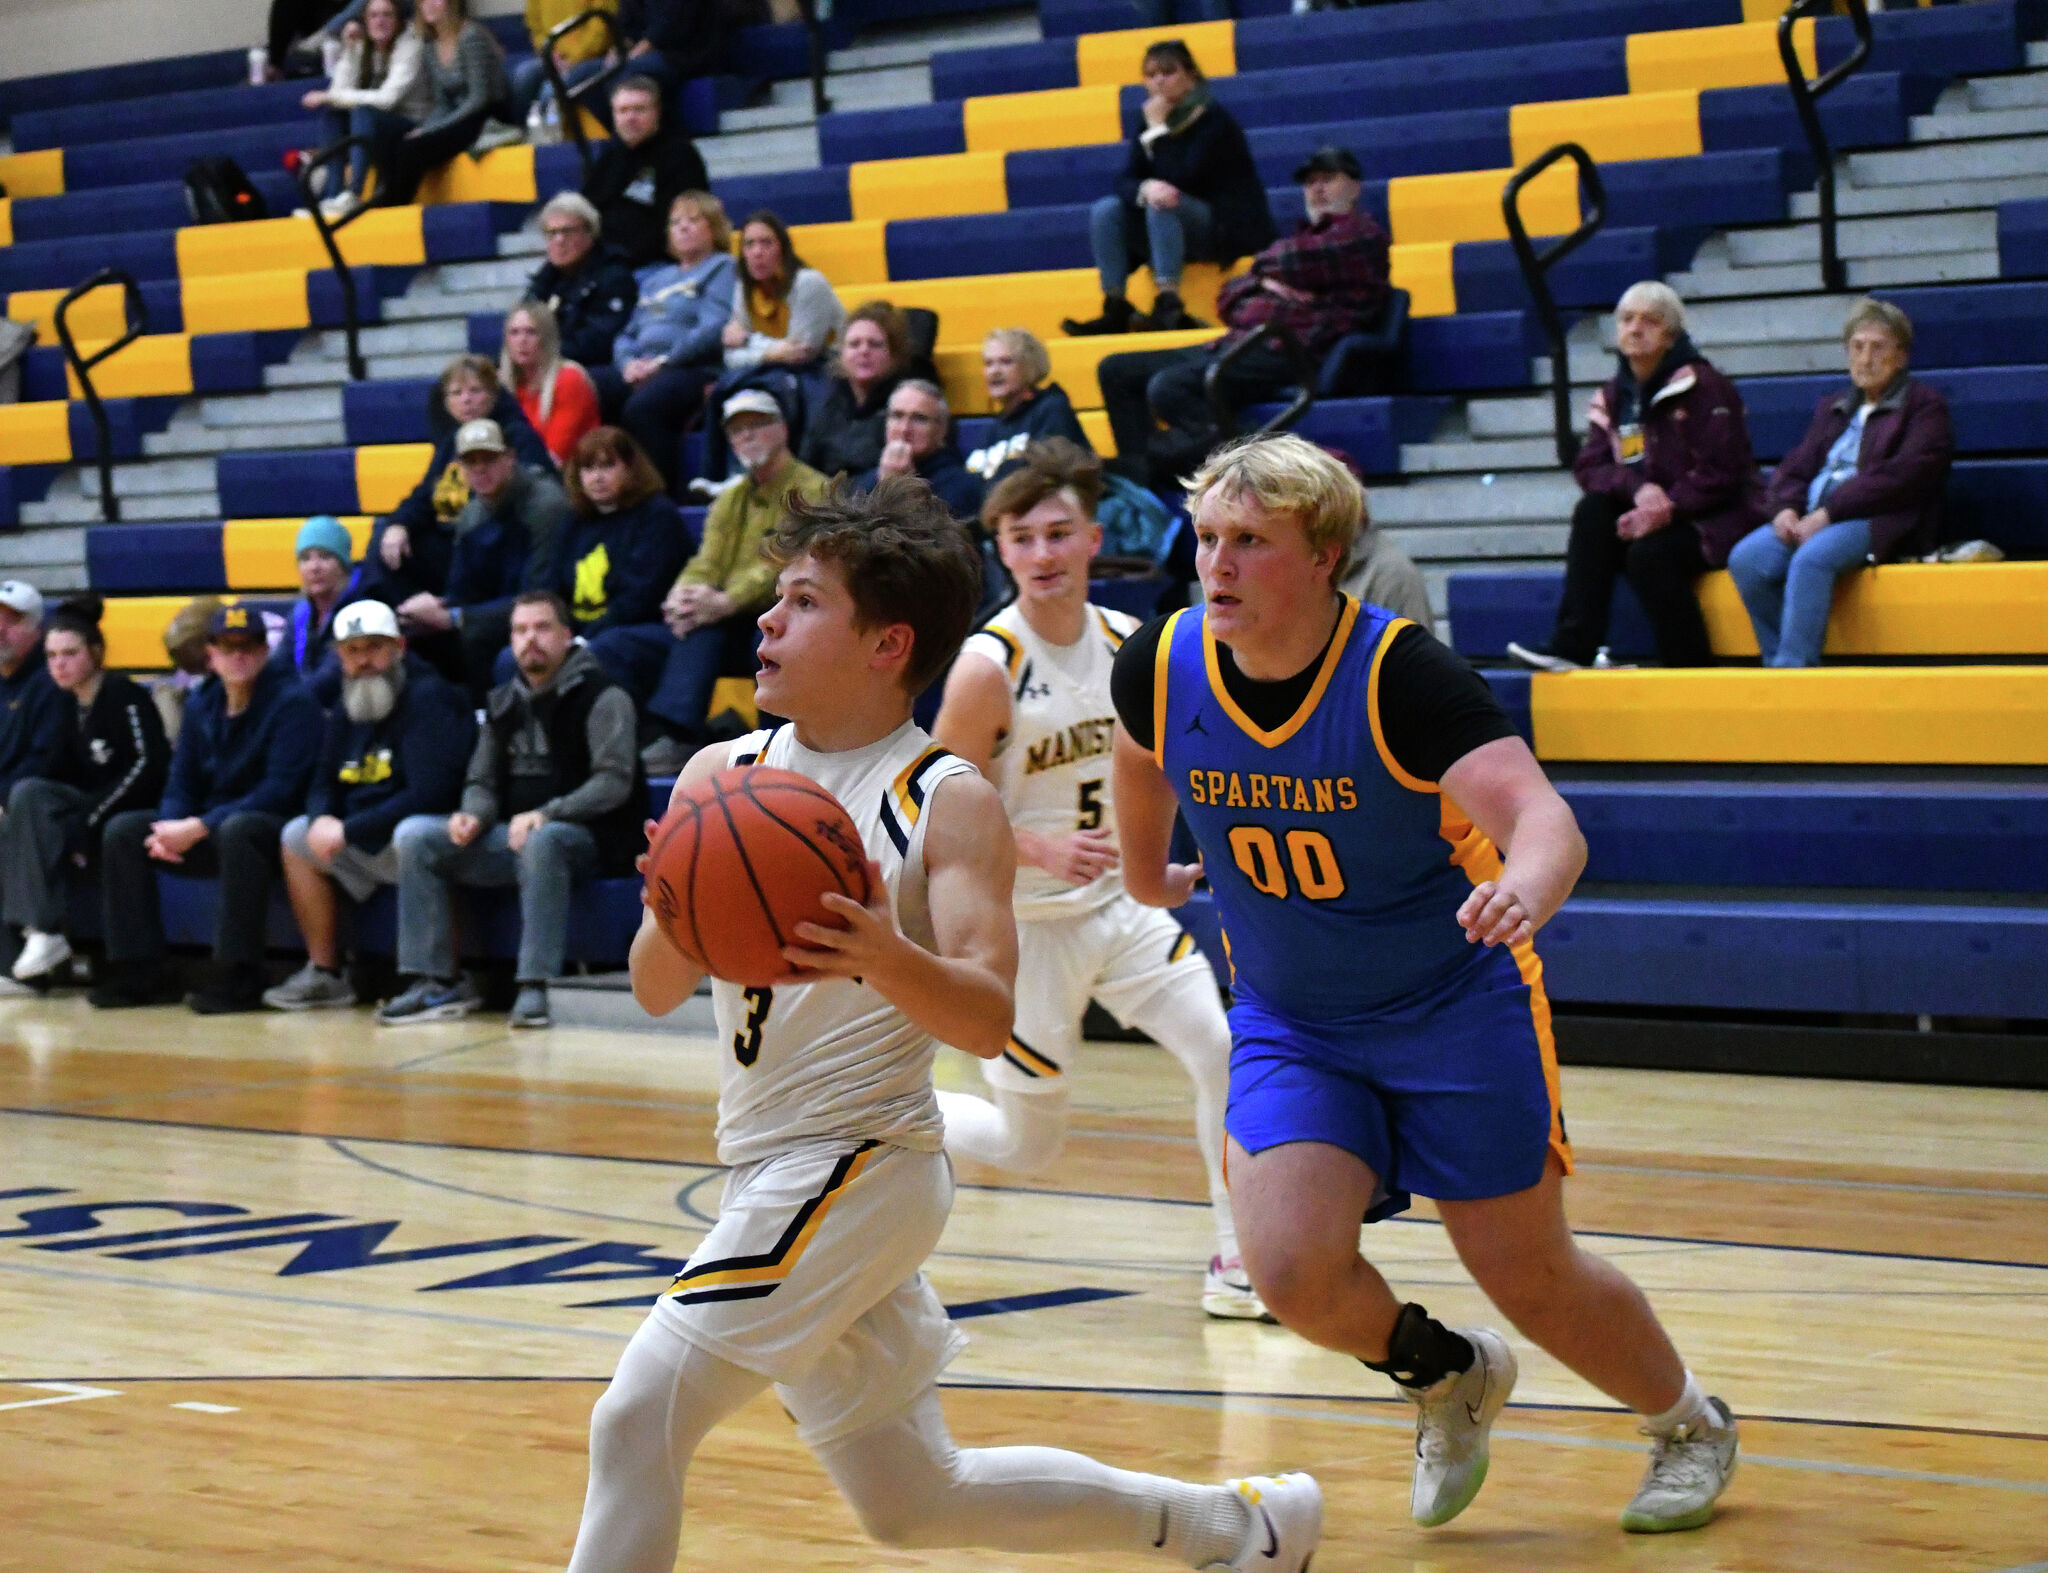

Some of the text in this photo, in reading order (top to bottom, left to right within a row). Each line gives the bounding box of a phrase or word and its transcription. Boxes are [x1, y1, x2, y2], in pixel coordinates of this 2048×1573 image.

[1076, 778, 1105, 830] 5
[1189, 768, 1358, 813] SPARTANS
[1226, 823, 1348, 902] 00
[733, 985, 774, 1069] 3
